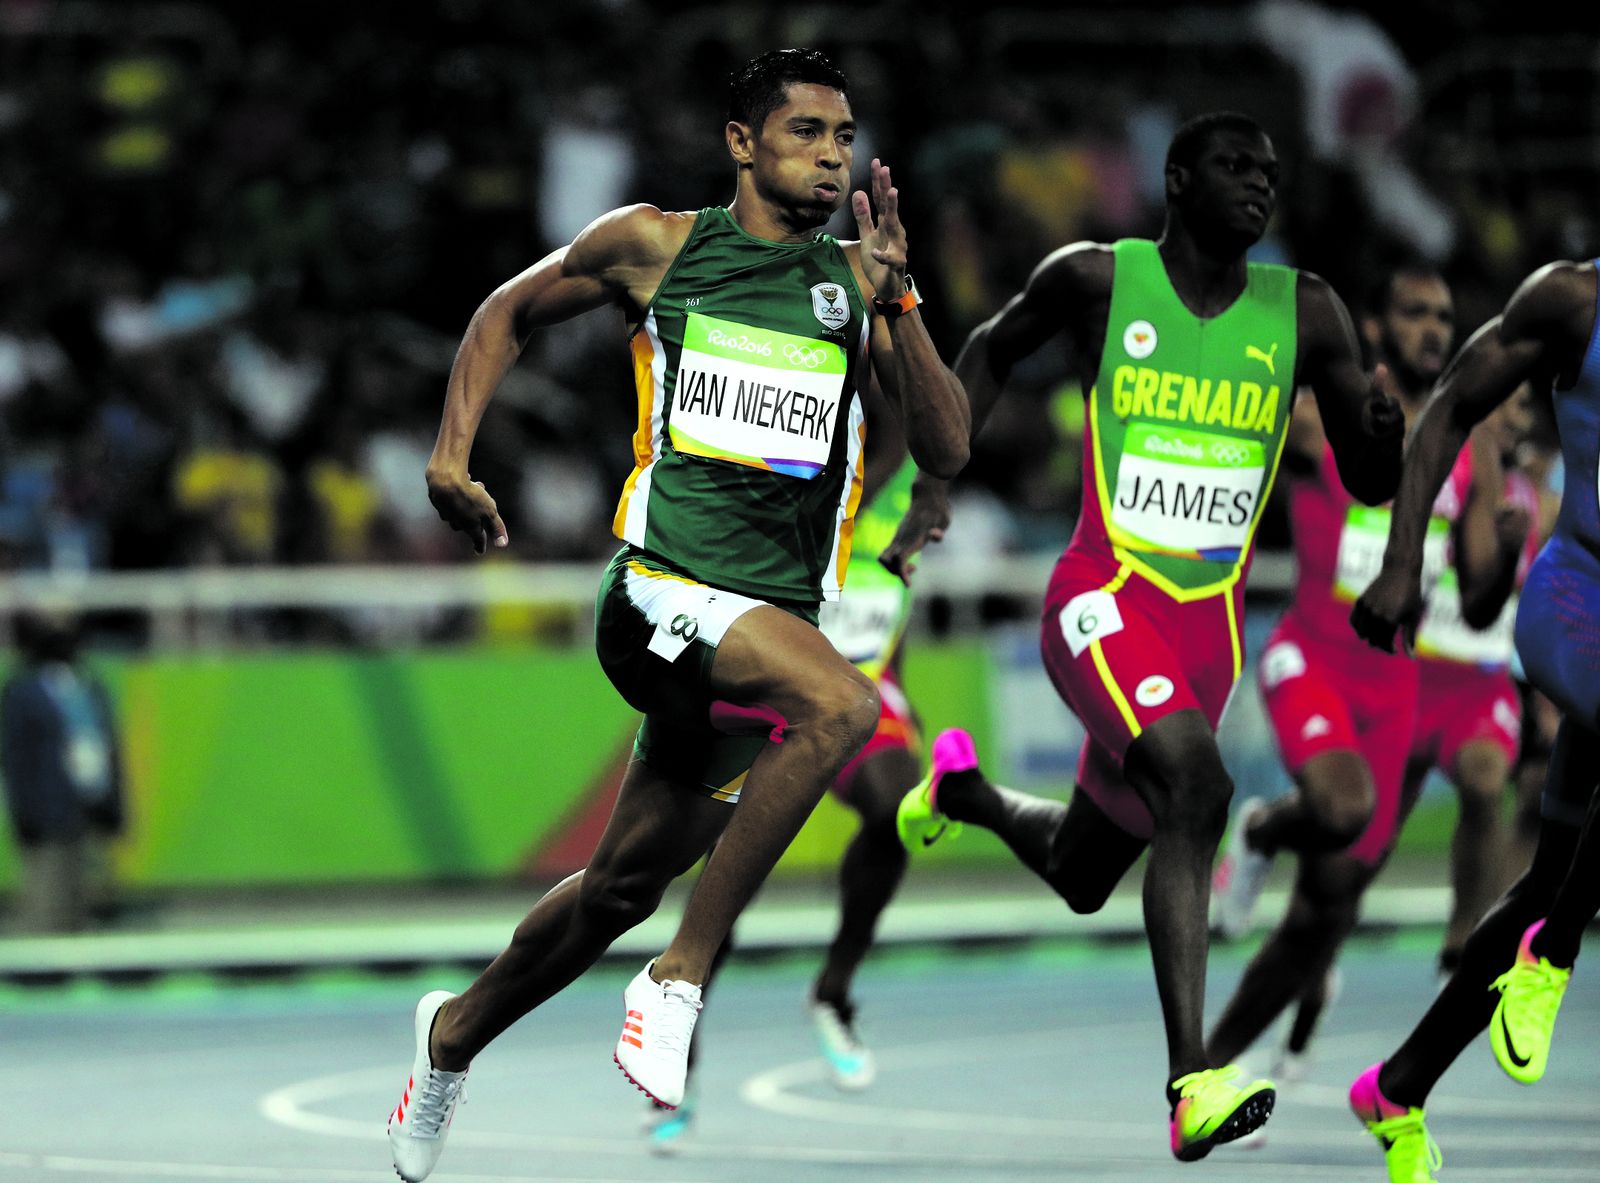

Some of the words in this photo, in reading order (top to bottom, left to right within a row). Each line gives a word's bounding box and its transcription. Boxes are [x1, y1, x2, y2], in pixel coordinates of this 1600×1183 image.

[679, 369, 728, 417] VAN
[733, 379, 835, 444] NIEKERK
[1112, 365, 1281, 435] GRENADA
[1119, 476, 1252, 527] JAMES
[671, 613, 699, 643] 8
[1077, 604, 1098, 635] 6
